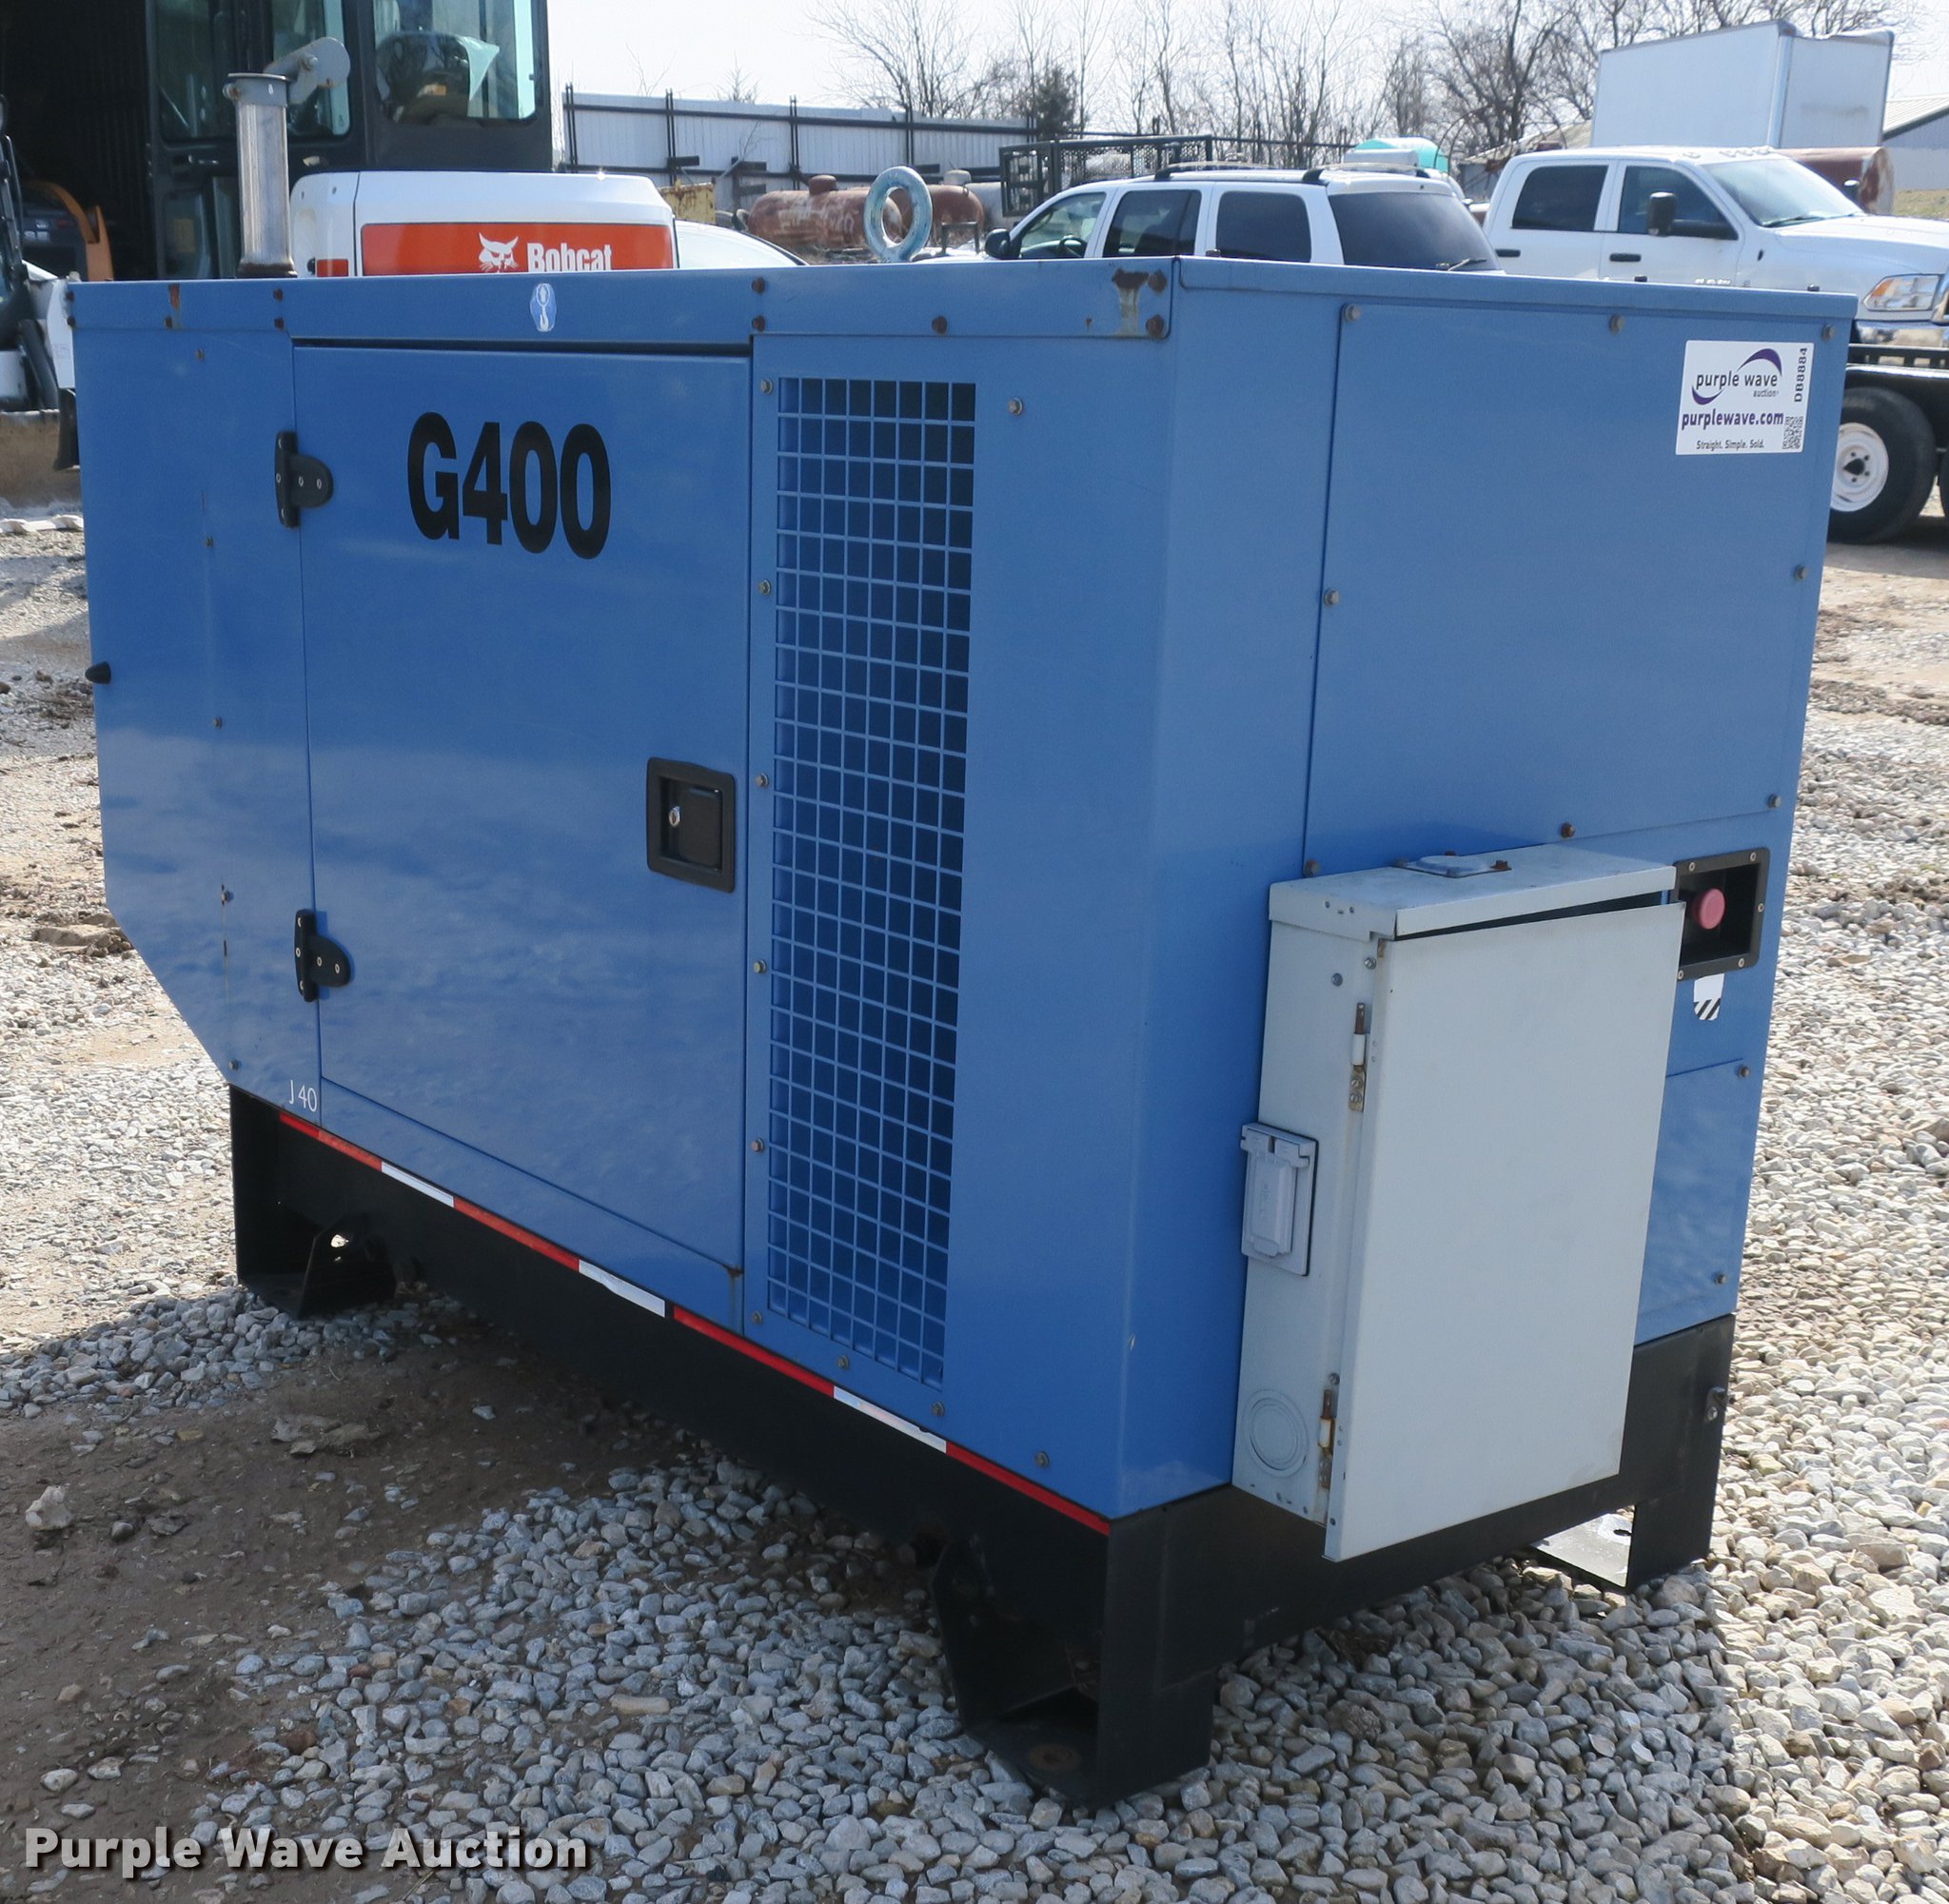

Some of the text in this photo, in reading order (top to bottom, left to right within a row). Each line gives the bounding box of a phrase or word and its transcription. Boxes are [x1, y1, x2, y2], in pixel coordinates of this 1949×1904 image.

[526, 242, 612, 272] Bobcat
[1696, 371, 1778, 390] purple wave
[1682, 408, 1784, 430] purplewave.com
[1696, 439, 1764, 451] Straight. Simple. Sold.
[407, 411, 611, 559] G400
